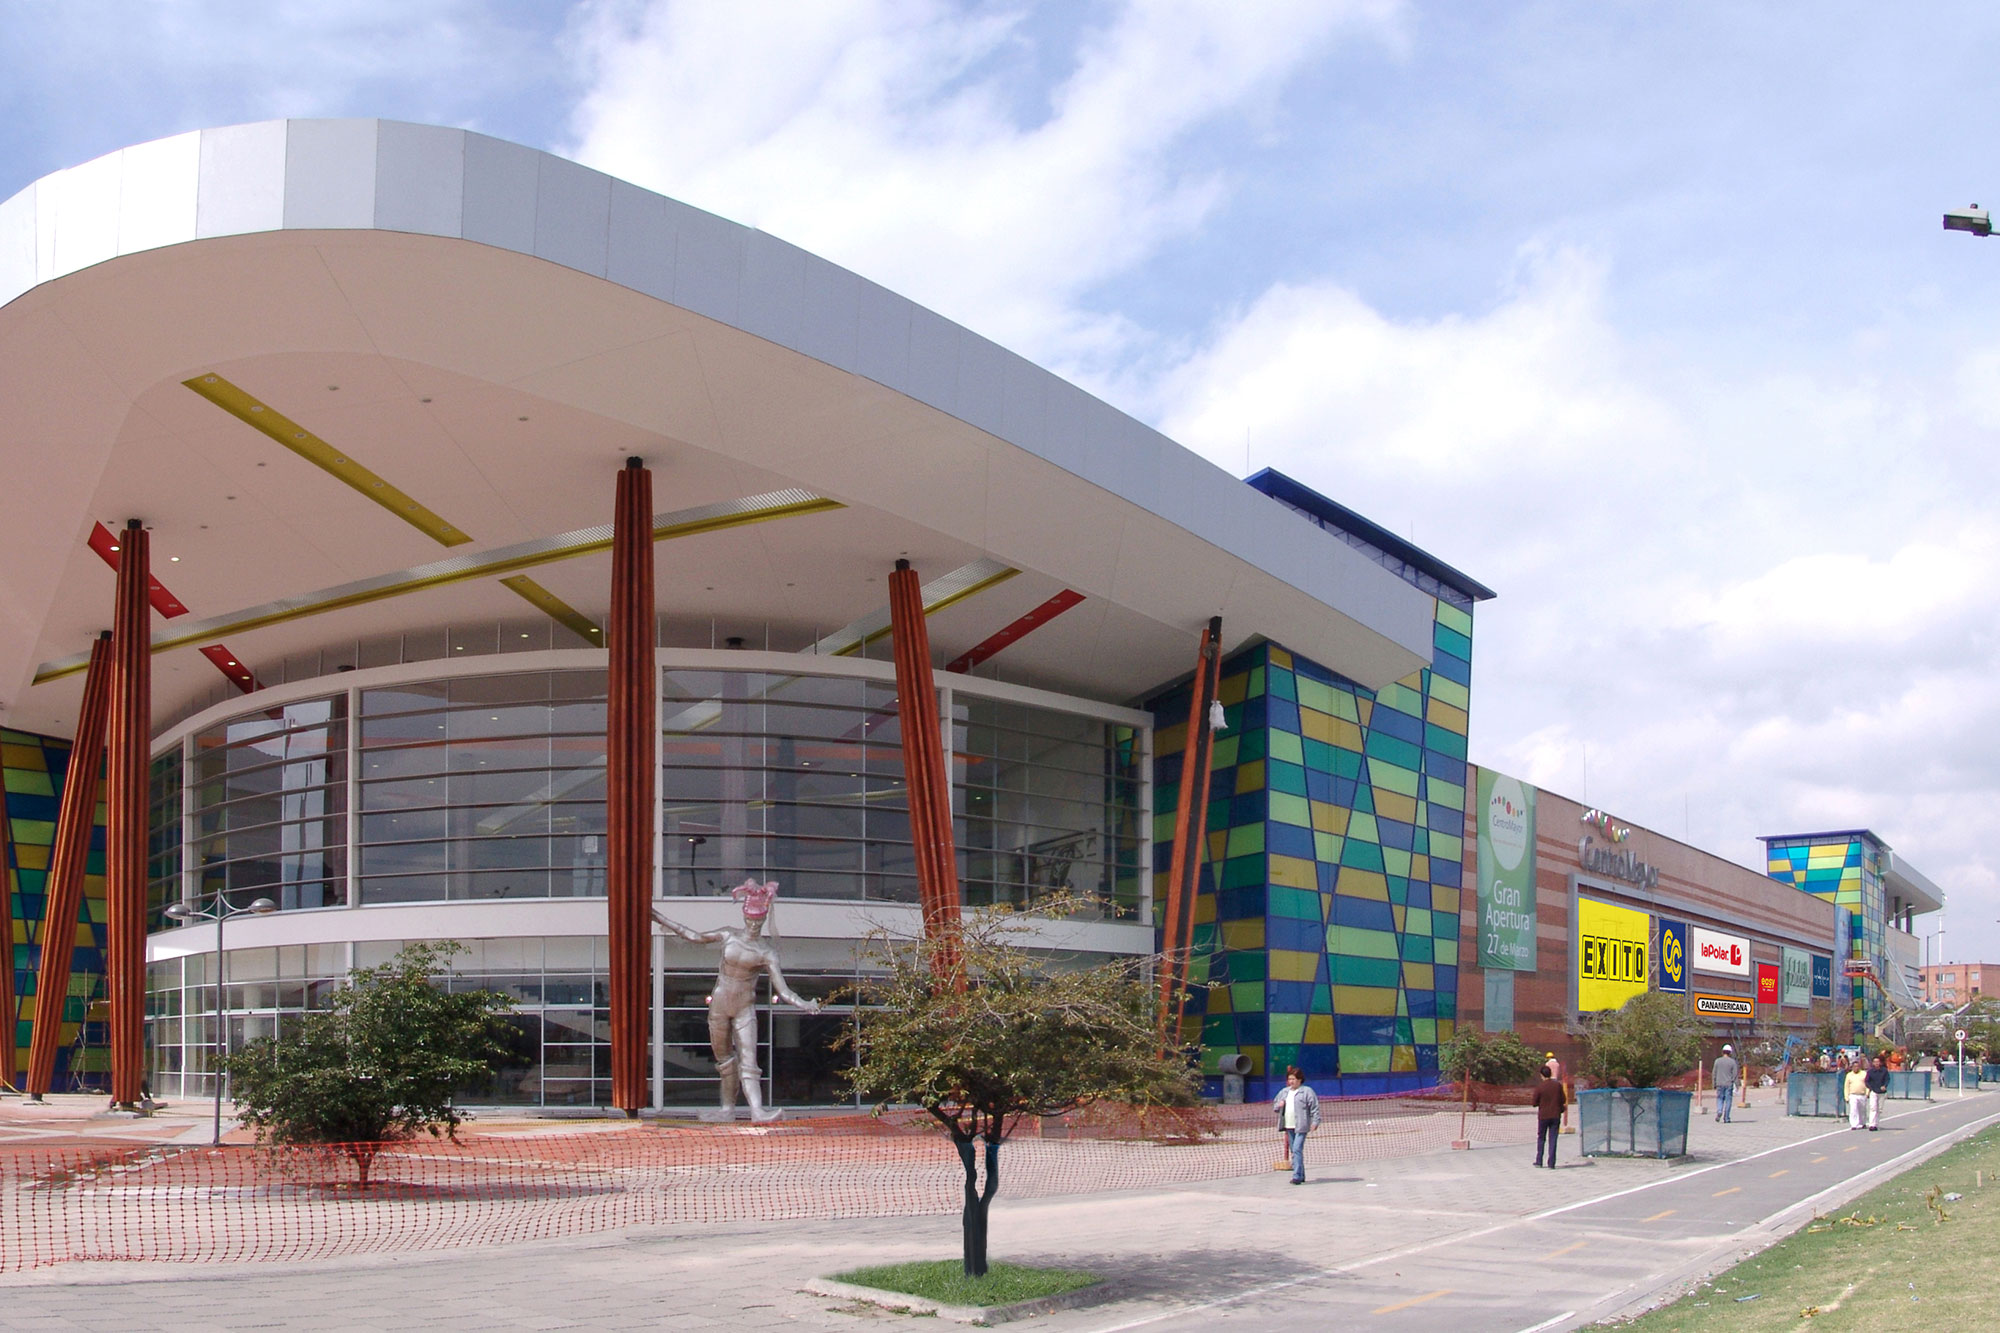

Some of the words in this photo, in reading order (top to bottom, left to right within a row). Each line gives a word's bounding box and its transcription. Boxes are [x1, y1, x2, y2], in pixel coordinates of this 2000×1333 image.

[1493, 879, 1521, 908] Gran
[1485, 902, 1530, 932] Apertura
[1487, 933, 1499, 955] 27
[1500, 941, 1509, 955] de
[1510, 942, 1529, 958] Marzo
[1583, 936, 1644, 982] EXITO
[1761, 977, 1775, 989] easy
[1701, 1000, 1748, 1012] PANAMERICANA
